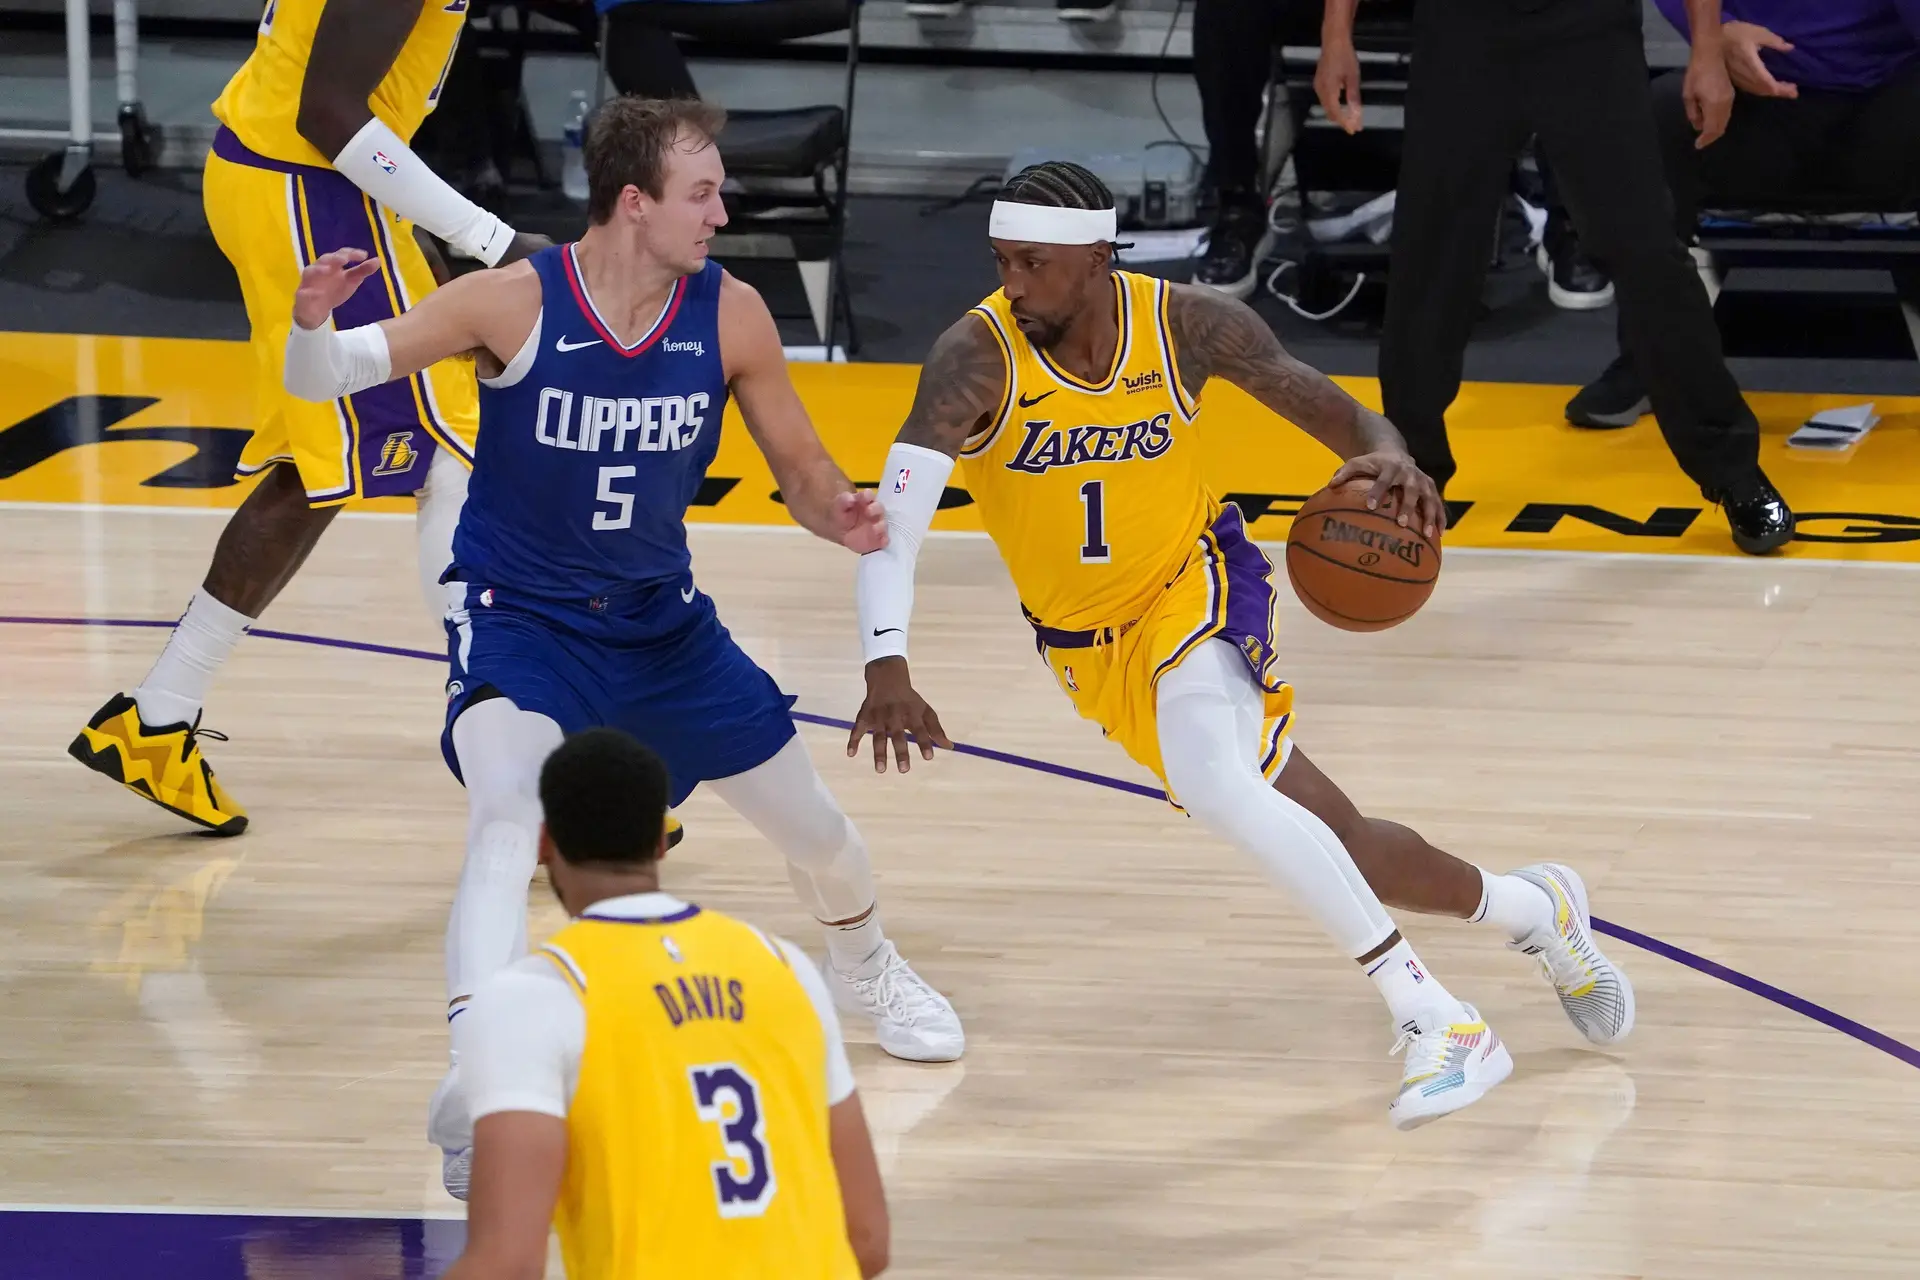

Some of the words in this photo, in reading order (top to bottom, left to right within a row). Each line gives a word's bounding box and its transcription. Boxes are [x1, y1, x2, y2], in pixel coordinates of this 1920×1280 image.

[662, 336, 706, 357] honey
[1121, 369, 1162, 389] wish
[1126, 383, 1164, 396] SHOPPING
[536, 386, 710, 453] CLIPPERS
[1004, 411, 1175, 476] LAKERS
[591, 465, 637, 532] 5
[1078, 479, 1112, 565] 1
[1320, 515, 1425, 568] SPALDING
[653, 975, 745, 1028] DAVIS
[687, 1061, 778, 1219] 3
